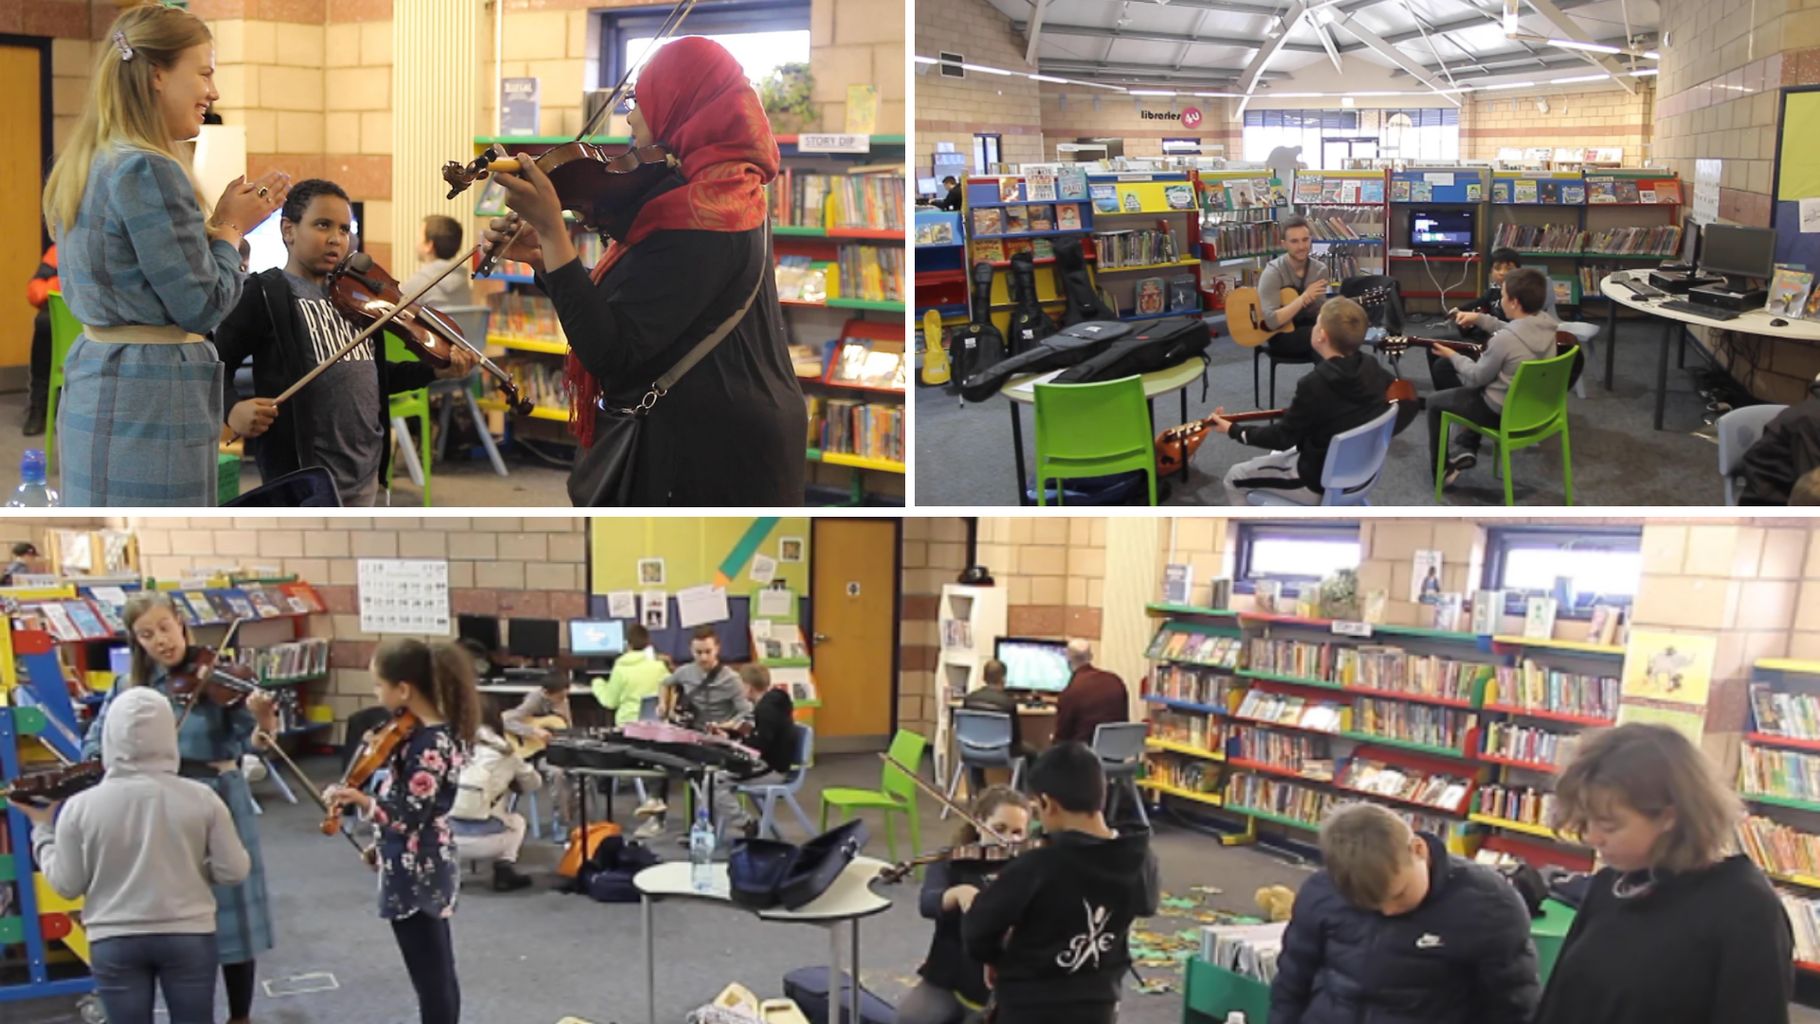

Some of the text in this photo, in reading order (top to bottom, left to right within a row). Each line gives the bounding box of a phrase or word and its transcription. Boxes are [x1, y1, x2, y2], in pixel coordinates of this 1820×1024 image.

[1141, 110, 1181, 120] libraries
[805, 135, 856, 147] STORY DIP
